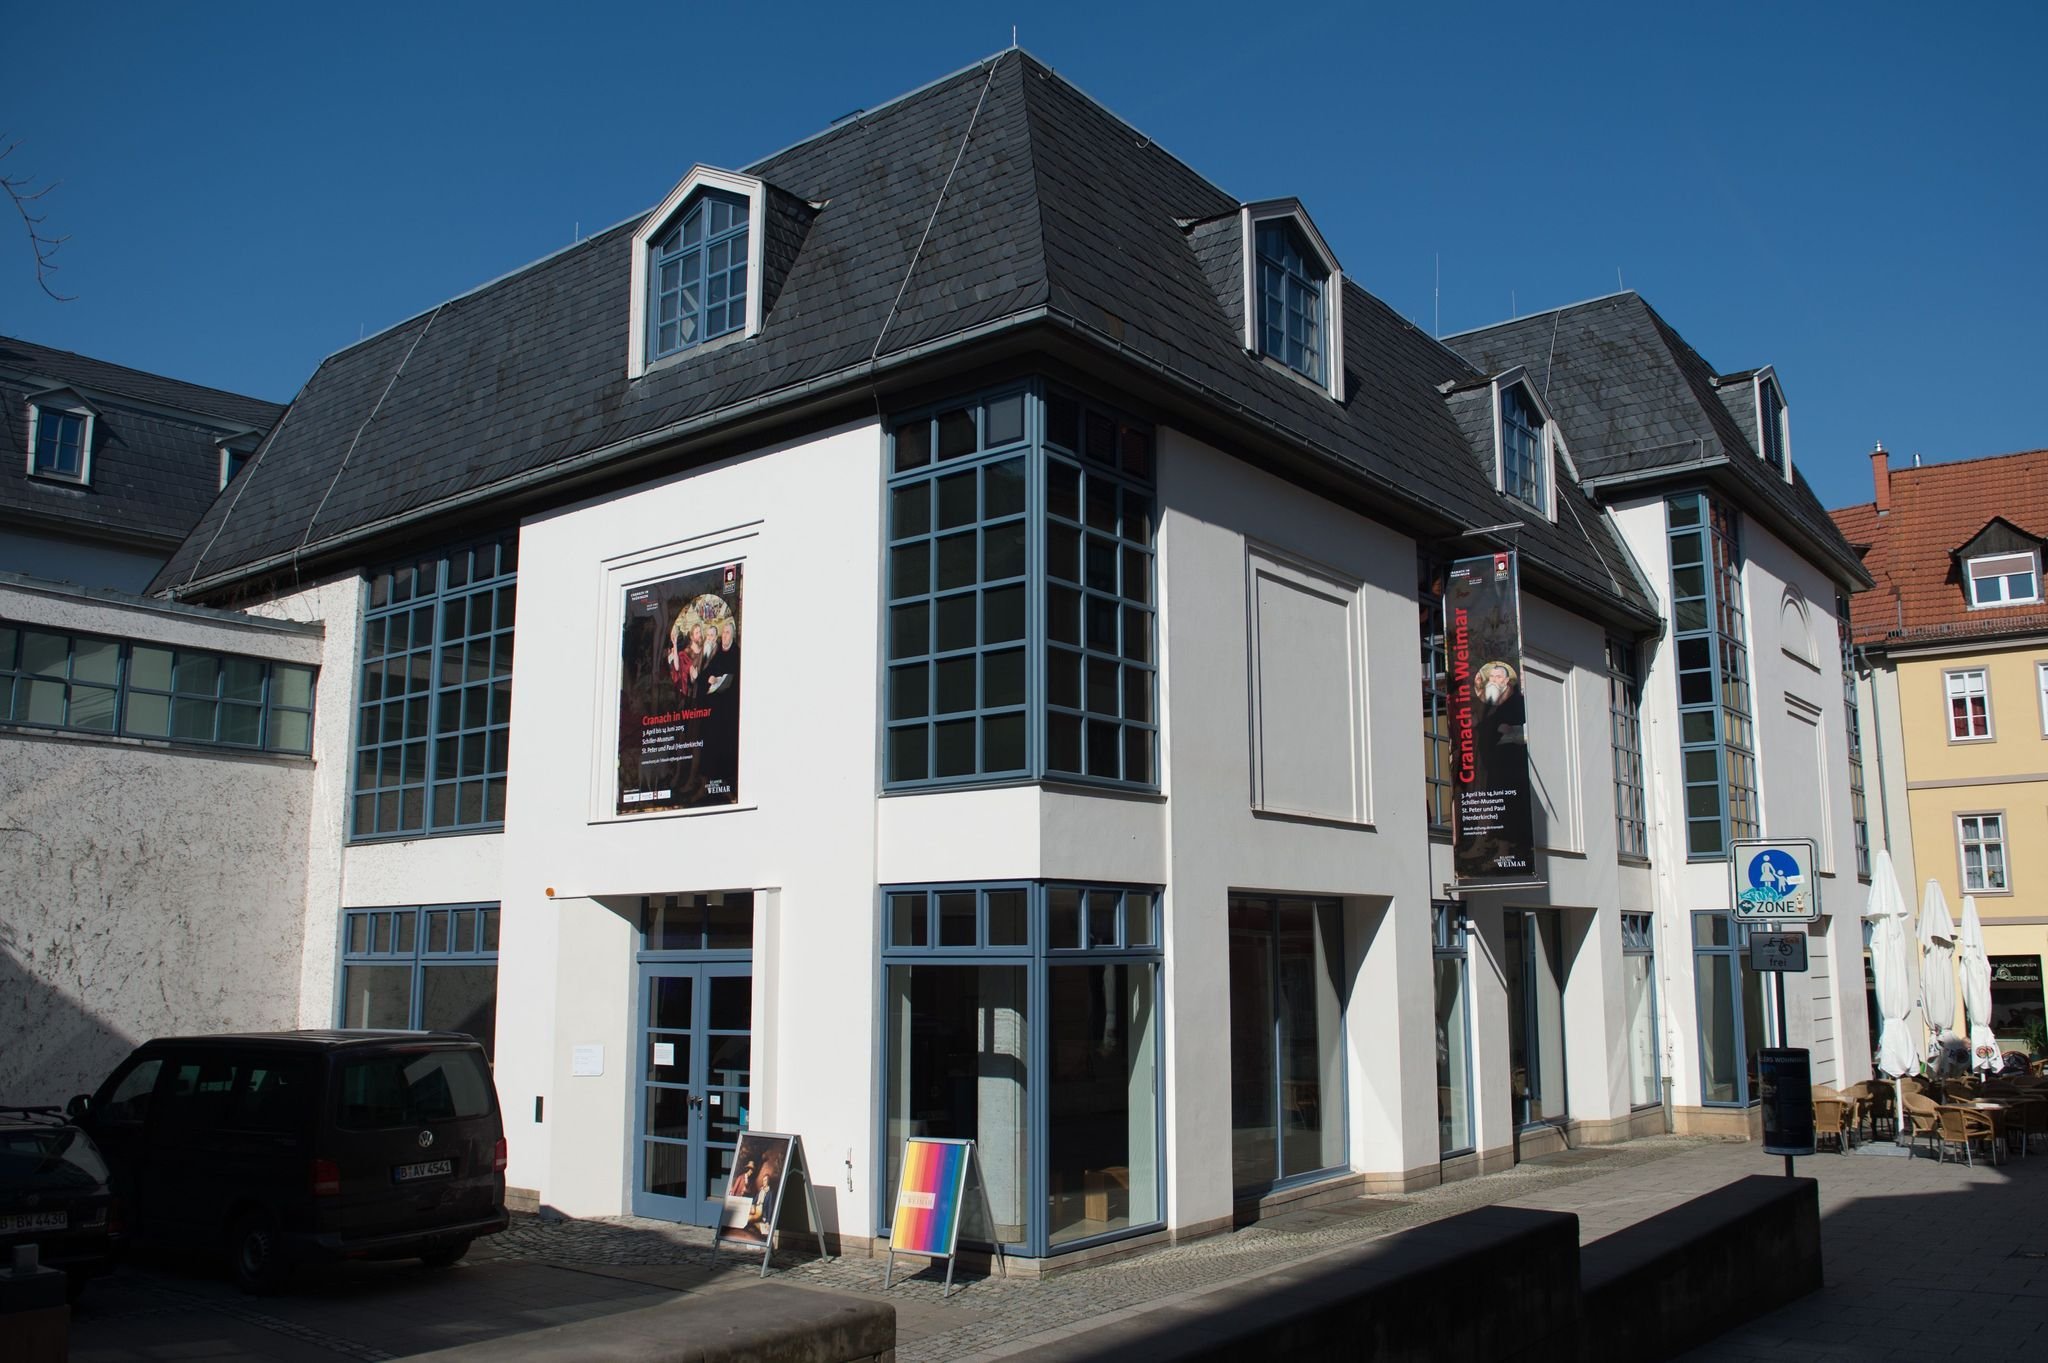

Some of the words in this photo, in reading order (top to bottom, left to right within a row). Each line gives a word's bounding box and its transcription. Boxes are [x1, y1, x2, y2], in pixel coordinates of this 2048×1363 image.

[1453, 608, 1470, 681] Weimar
[1456, 684, 1471, 704] in
[643, 712, 671, 725] Cranach
[673, 711, 681, 720] in
[682, 708, 711, 719] Weimar
[646, 728, 656, 736] April
[642, 736, 674, 745] Schiller-Museum
[1456, 707, 1475, 783] Cranach
[707, 785, 731, 794] WEIMAR
[1461, 798, 1504, 806] Schiller-Museum
[1462, 813, 1499, 822] (Herderkirche)
[1756, 901, 1795, 913] ZONE
[1769, 958, 1787, 967] frei
[400, 1167, 408, 1178] B
[414, 1164, 425, 1176] AV
[427, 1161, 450, 1174] 4541
